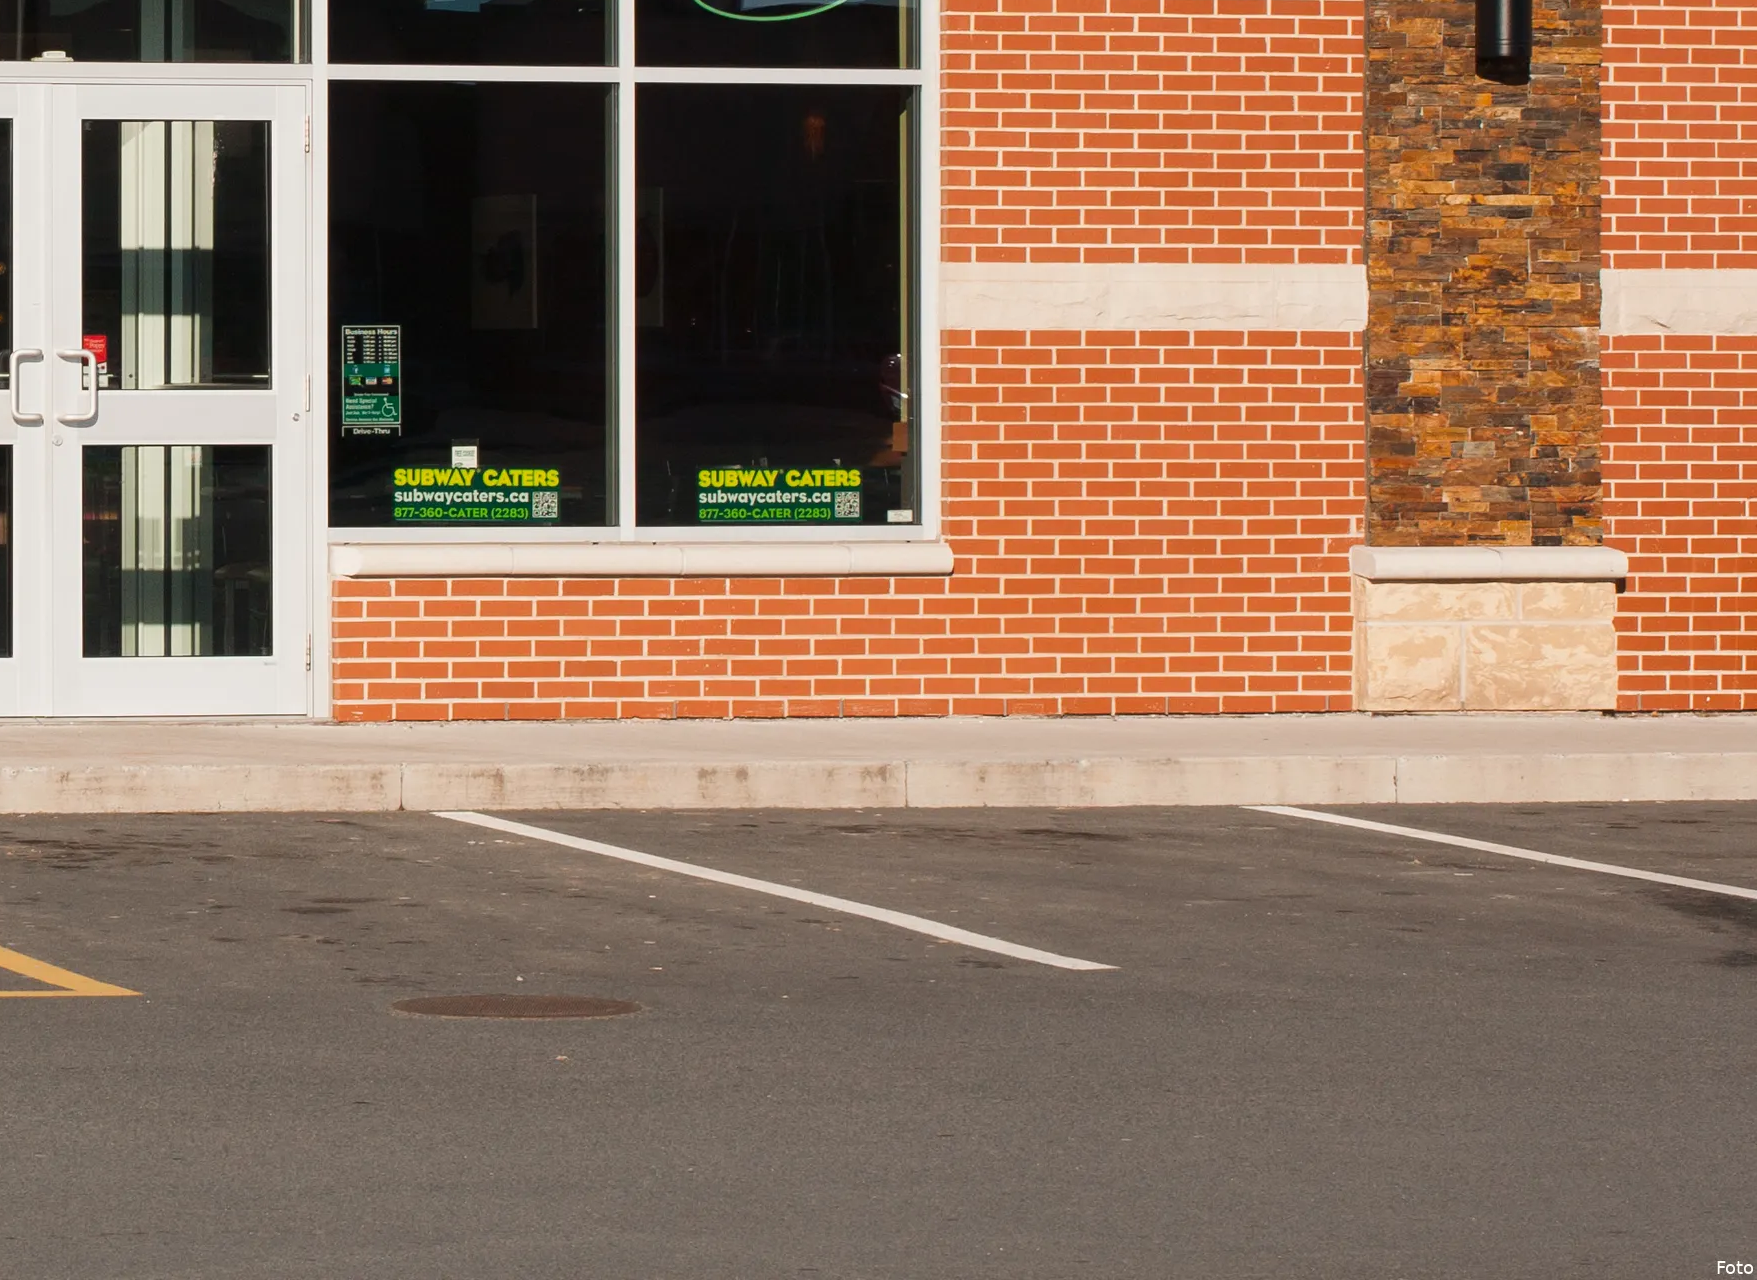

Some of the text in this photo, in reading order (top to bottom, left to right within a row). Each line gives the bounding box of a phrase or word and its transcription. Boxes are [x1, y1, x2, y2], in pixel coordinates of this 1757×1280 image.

[394, 468, 560, 488] SUBWAY CATERS
[698, 469, 862, 488] SUBWAY CATERS
[394, 489, 529, 504] subwaycaters.ca
[699, 490, 832, 506] subwaycaters.ca
[394, 506, 529, 520] 877-360-CATER (2283)
[699, 507, 832, 521] 877-360-CATER (2283)
